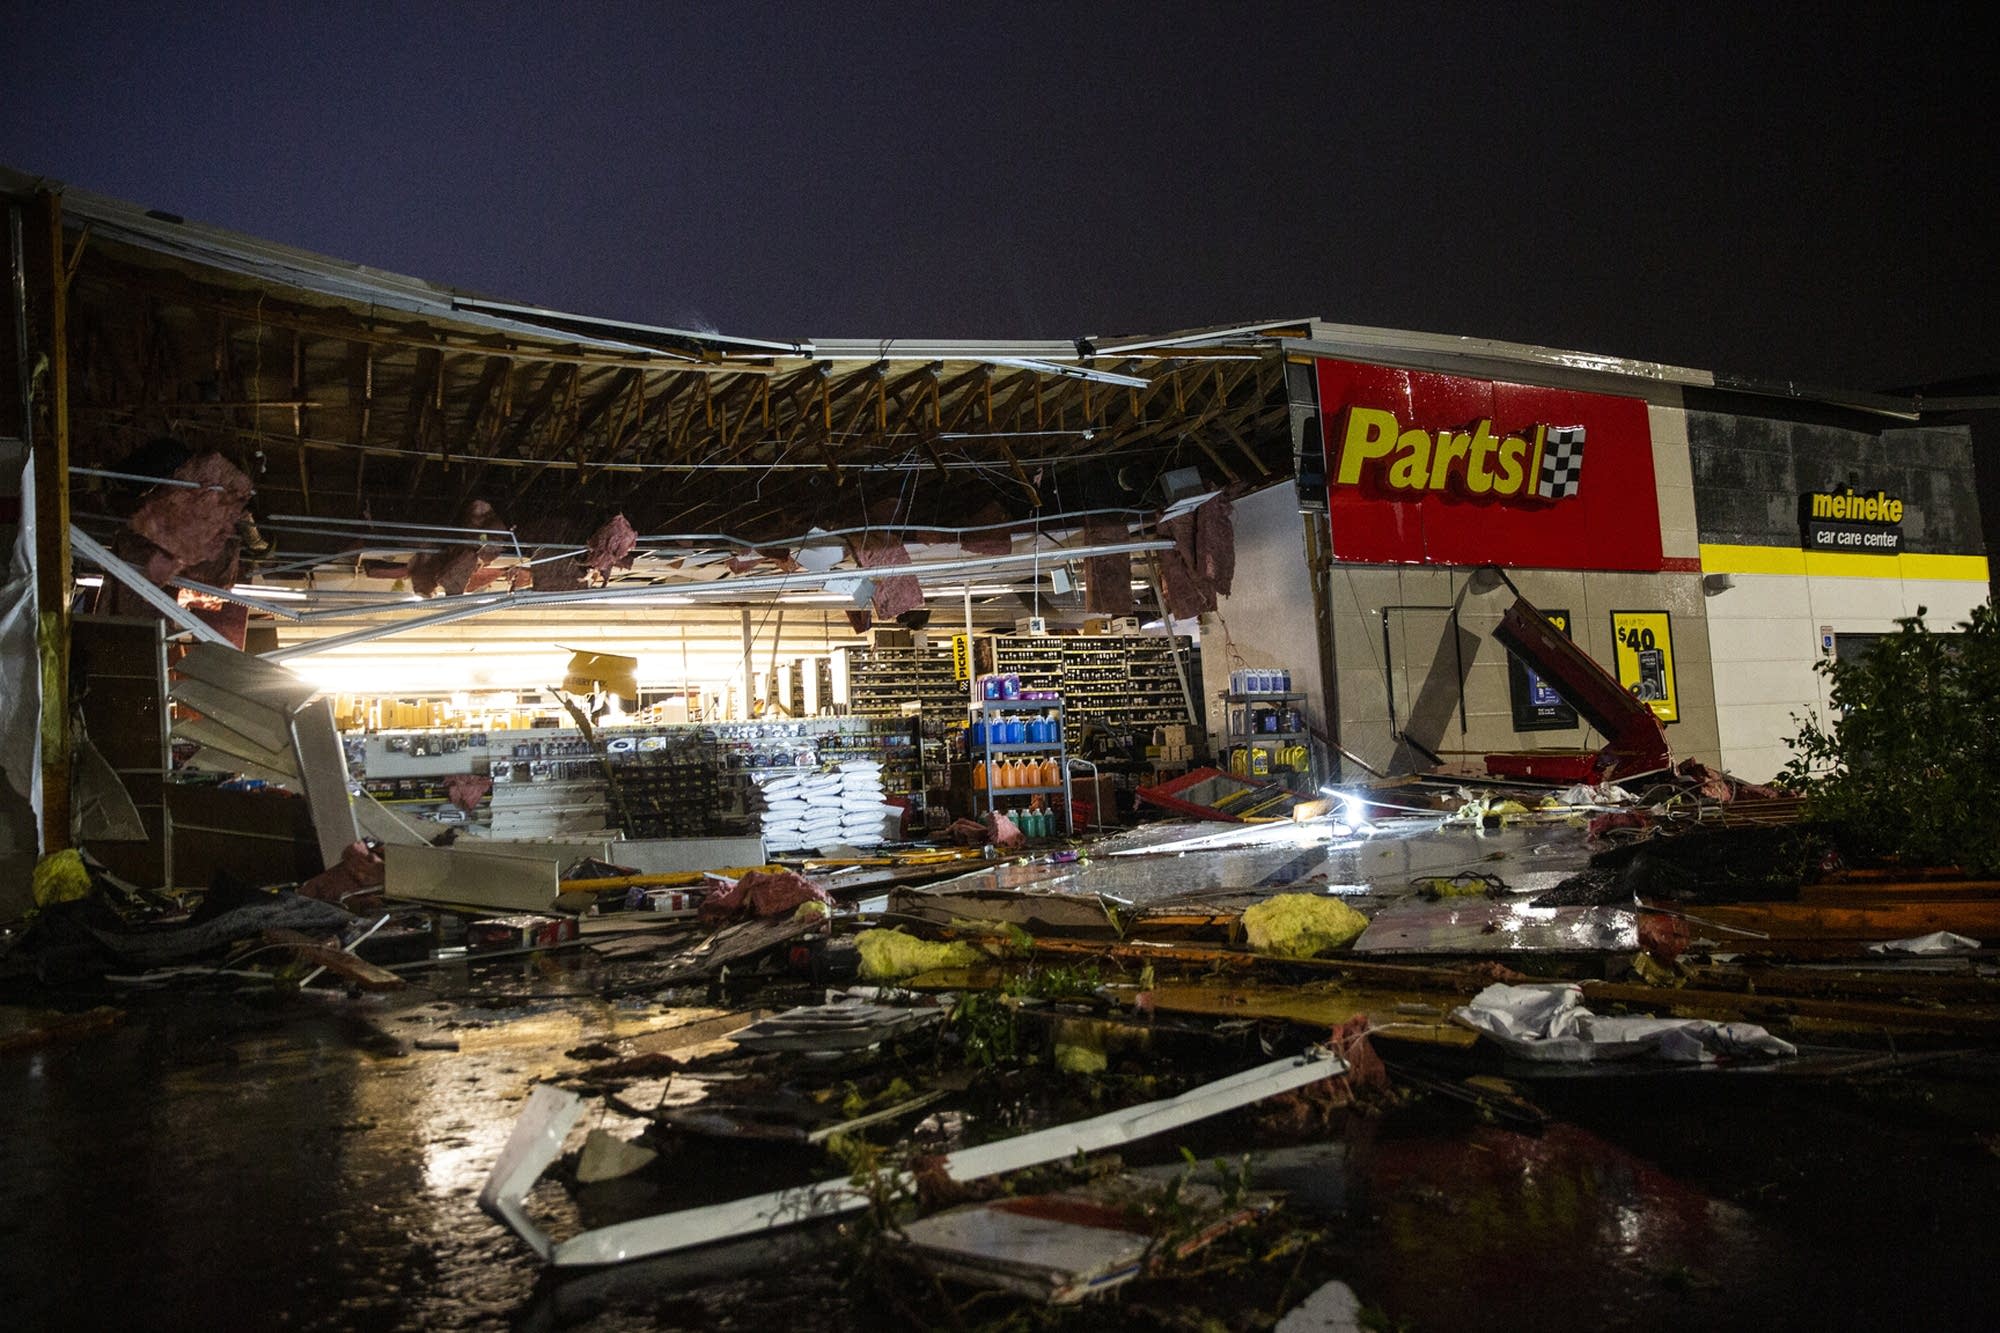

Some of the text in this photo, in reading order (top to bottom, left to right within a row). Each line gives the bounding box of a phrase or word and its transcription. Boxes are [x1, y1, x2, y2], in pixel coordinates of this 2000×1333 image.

[1337, 407, 1526, 494] Parts
[1812, 489, 1903, 522] meineke
[1817, 531, 1898, 547] car care center
[1618, 627, 1655, 652] $40
[957, 638, 967, 678] PICKUP
